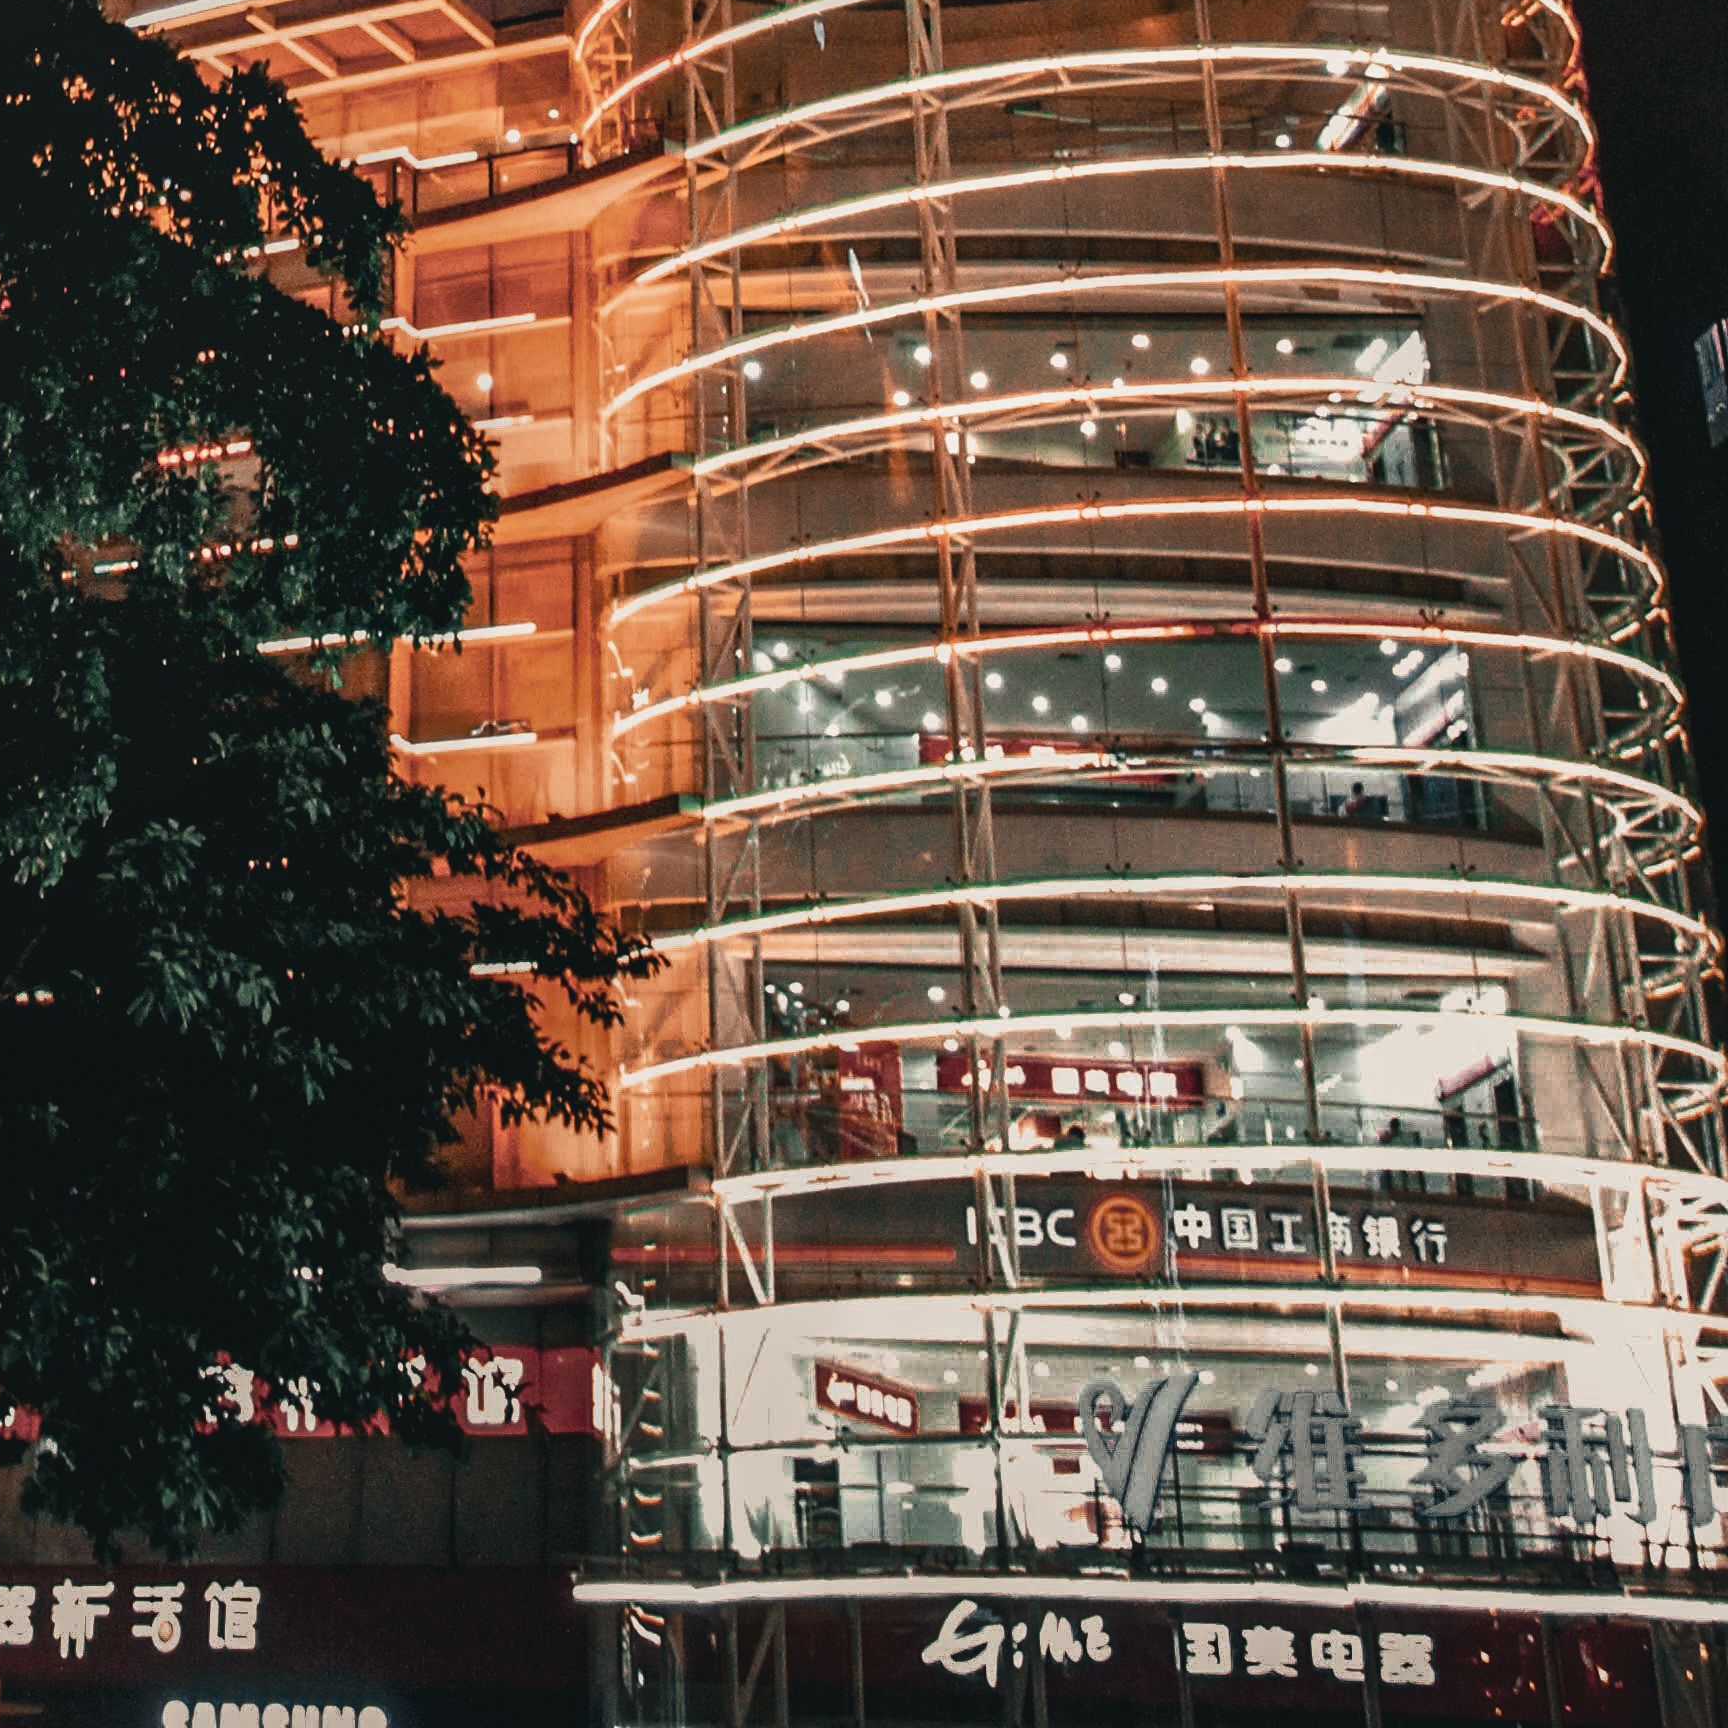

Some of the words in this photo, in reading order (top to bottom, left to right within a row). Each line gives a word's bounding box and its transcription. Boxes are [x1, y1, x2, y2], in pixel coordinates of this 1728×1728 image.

[1173, 1202, 1448, 1264] 中国工商银行
[1173, 1621, 1436, 1686] 国美电器
